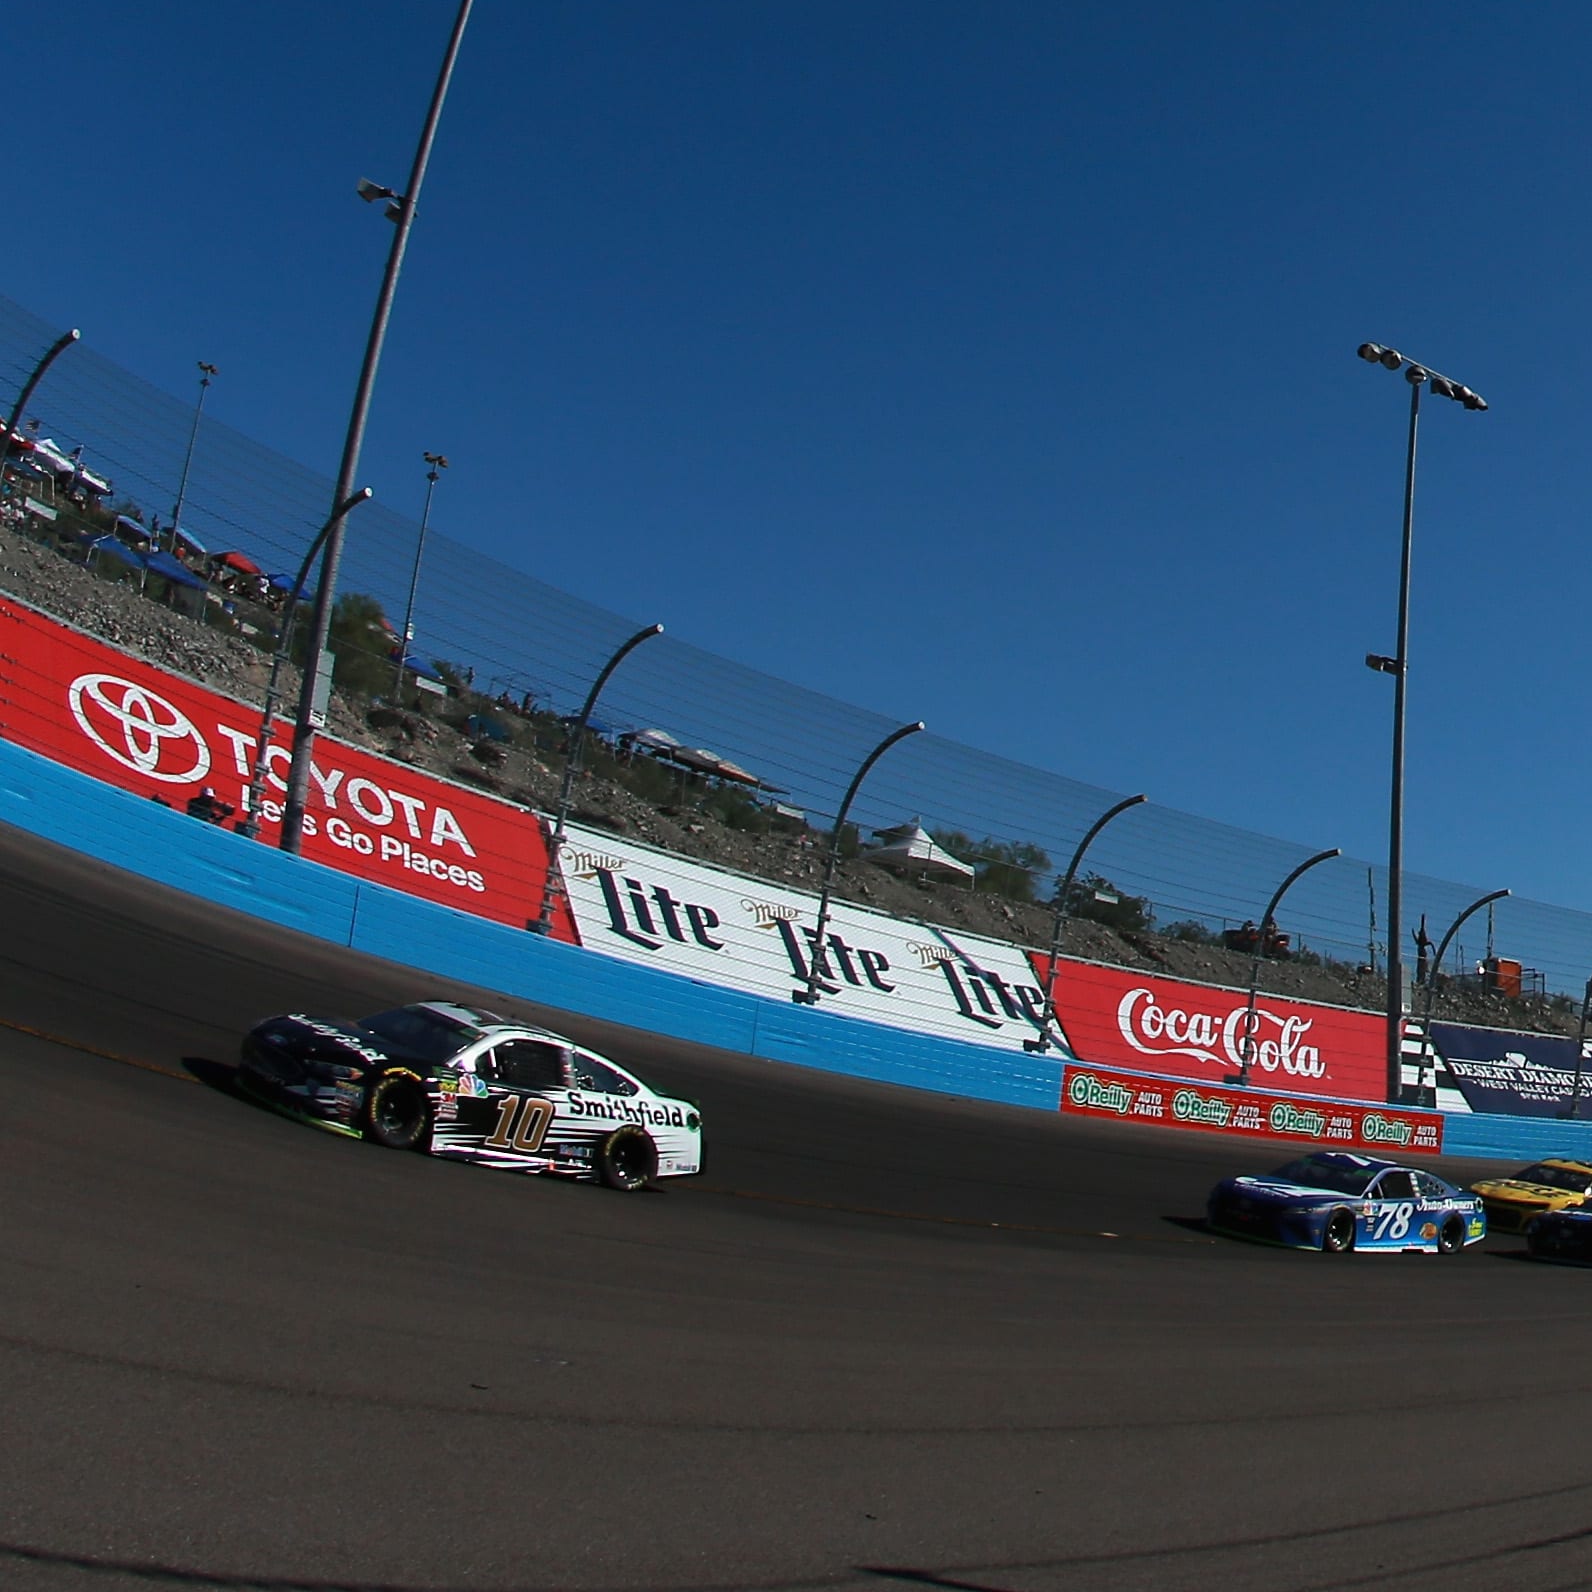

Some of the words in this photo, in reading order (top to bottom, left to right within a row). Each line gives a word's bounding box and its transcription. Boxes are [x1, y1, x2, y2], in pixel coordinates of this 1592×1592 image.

[217, 723, 476, 857] TOYOTA
[241, 785, 318, 836] Lets
[326, 817, 374, 856] Go
[381, 835, 486, 892] Places
[559, 846, 627, 872] Miller
[589, 864, 725, 950] Lite
[769, 914, 896, 995] Lite
[932, 957, 1050, 1029] Lite
[1117, 988, 1326, 1079] Coca-Cola
[1450, 1062, 1517, 1081] DESERT
[1478, 1079, 1510, 1091] WEST
[1512, 1080, 1550, 1094] VALLEY
[1552, 1085, 1590, 1098] CASO
[1071, 1073, 1134, 1115] O'Reilly
[1138, 1091, 1162, 1105] AUTO
[1134, 1103, 1163, 1117] PARTS
[1173, 1089, 1234, 1127] O'Reilly
[1236, 1105, 1259, 1118] AUTO
[484, 1095, 555, 1153] 10
[568, 1092, 683, 1127] Smithfield
[1232, 1116, 1261, 1130] PARTS
[1269, 1102, 1327, 1139] O'Reilly
[1330, 1116, 1352, 1128] AUTO
[1327, 1127, 1353, 1140] PARTS
[1361, 1112, 1415, 1148] O'Reilly
[1416, 1125, 1437, 1136] AUTO
[1413, 1136, 1438, 1147] PARTS
[1374, 1202, 1413, 1240] 78
